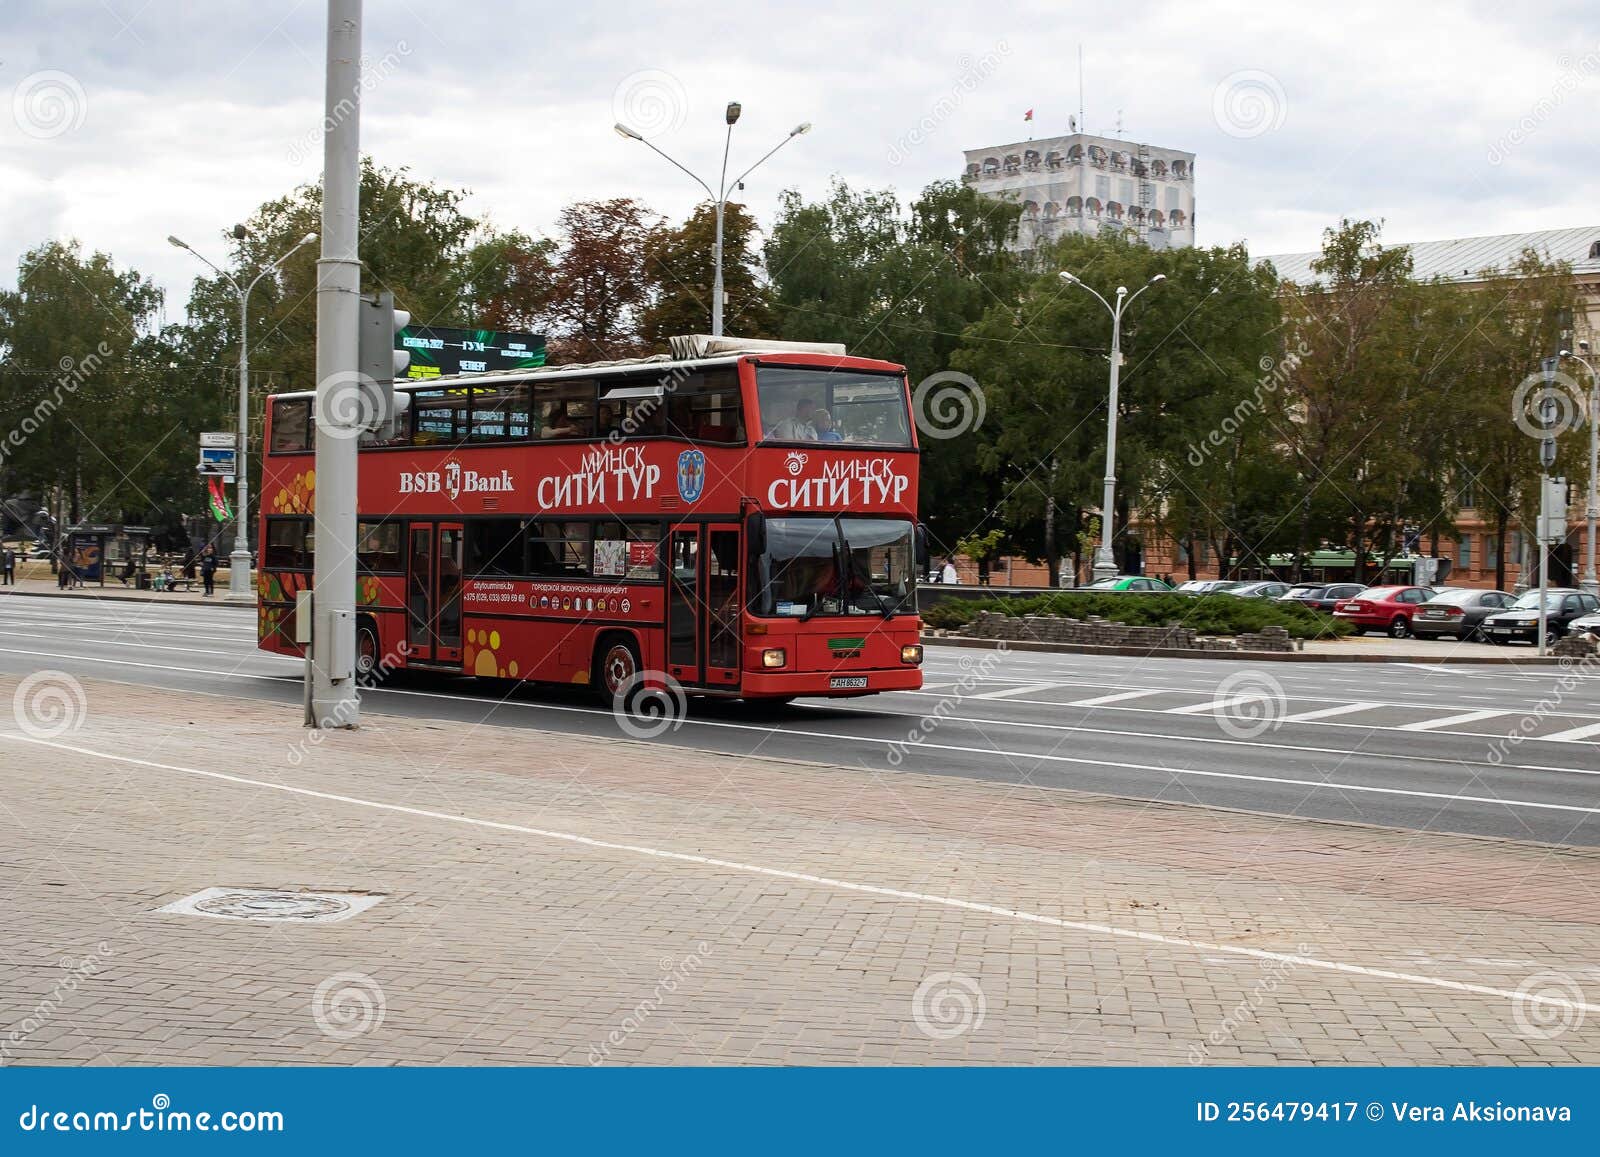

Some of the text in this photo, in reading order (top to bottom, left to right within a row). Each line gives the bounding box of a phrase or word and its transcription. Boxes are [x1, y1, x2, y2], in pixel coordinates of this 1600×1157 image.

[581, 445, 646, 474] МИНСК
[822, 458, 895, 480] МИНСК
[399, 470, 514, 493] BSB Bank
[537, 464, 661, 510] СИТИ ТУР
[767, 475, 909, 509] СИТИ ТУР
[531, 583, 628, 594] ГОРОДСКОЙ ЭКСКУРСИОННЫЙ МАРШРУТ
